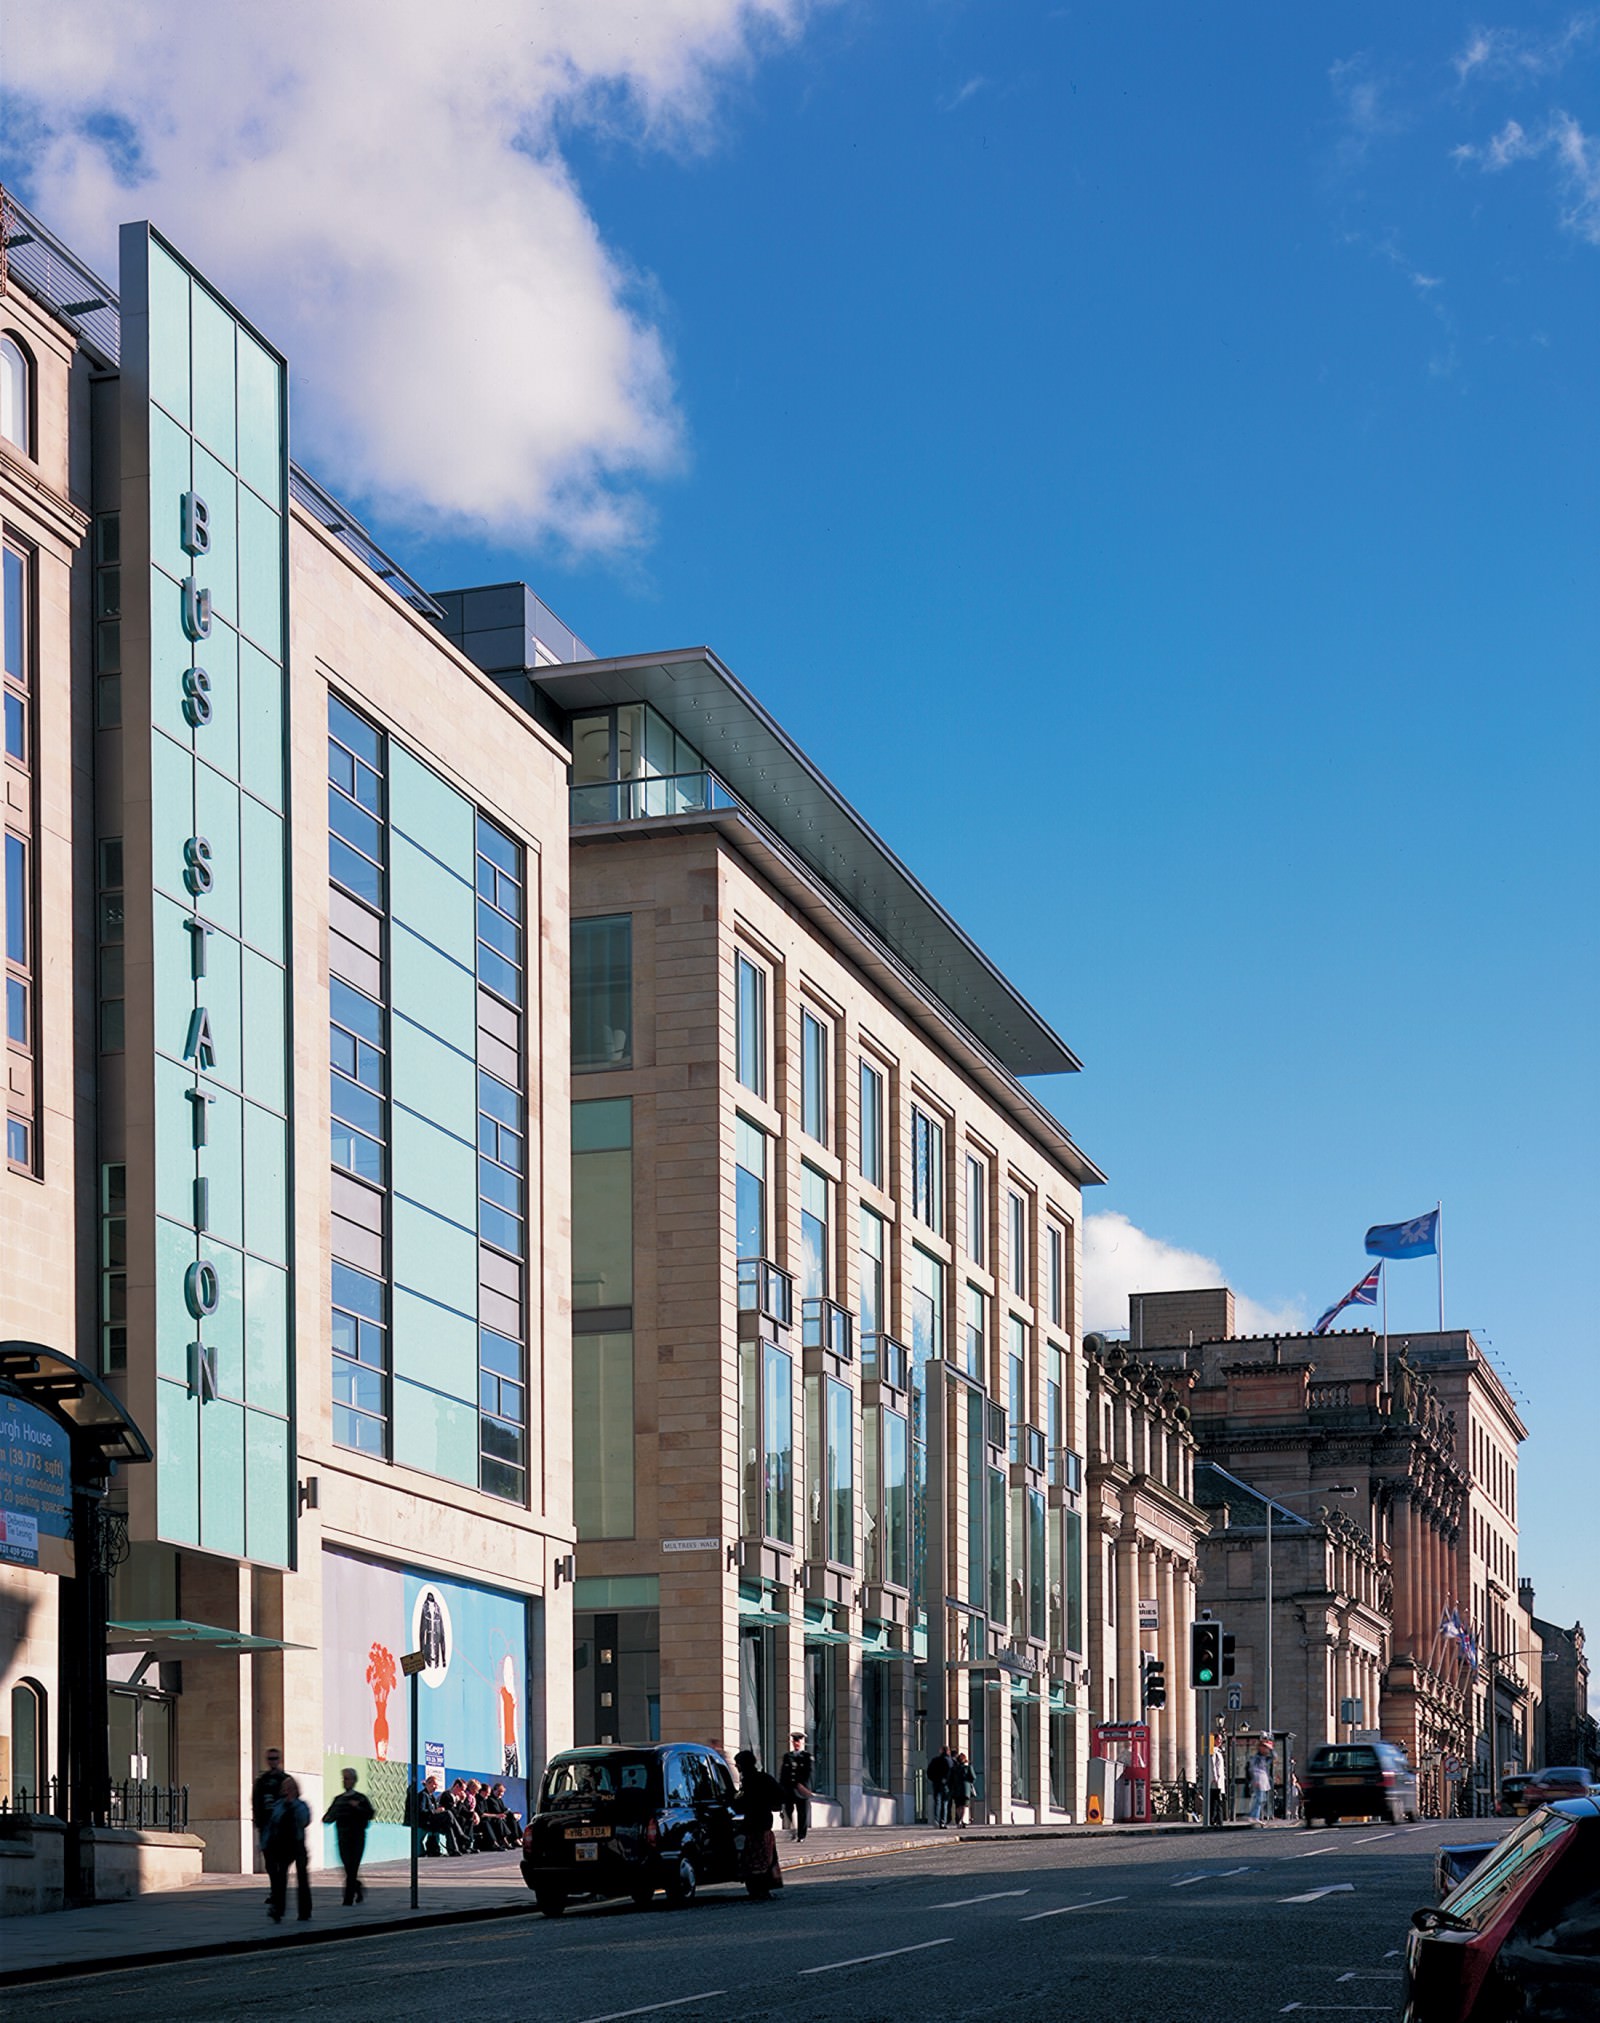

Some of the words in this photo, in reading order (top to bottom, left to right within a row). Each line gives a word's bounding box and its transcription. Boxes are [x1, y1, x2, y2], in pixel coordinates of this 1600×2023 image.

[180, 491, 213, 728] BUS
[183, 836, 220, 1405] STATION
[23, 1423, 52, 1448] House
[26, 1478, 64, 1496] conditioned
[15, 1494, 40, 1512] parking
[6, 1513, 36, 1530] Debenham
